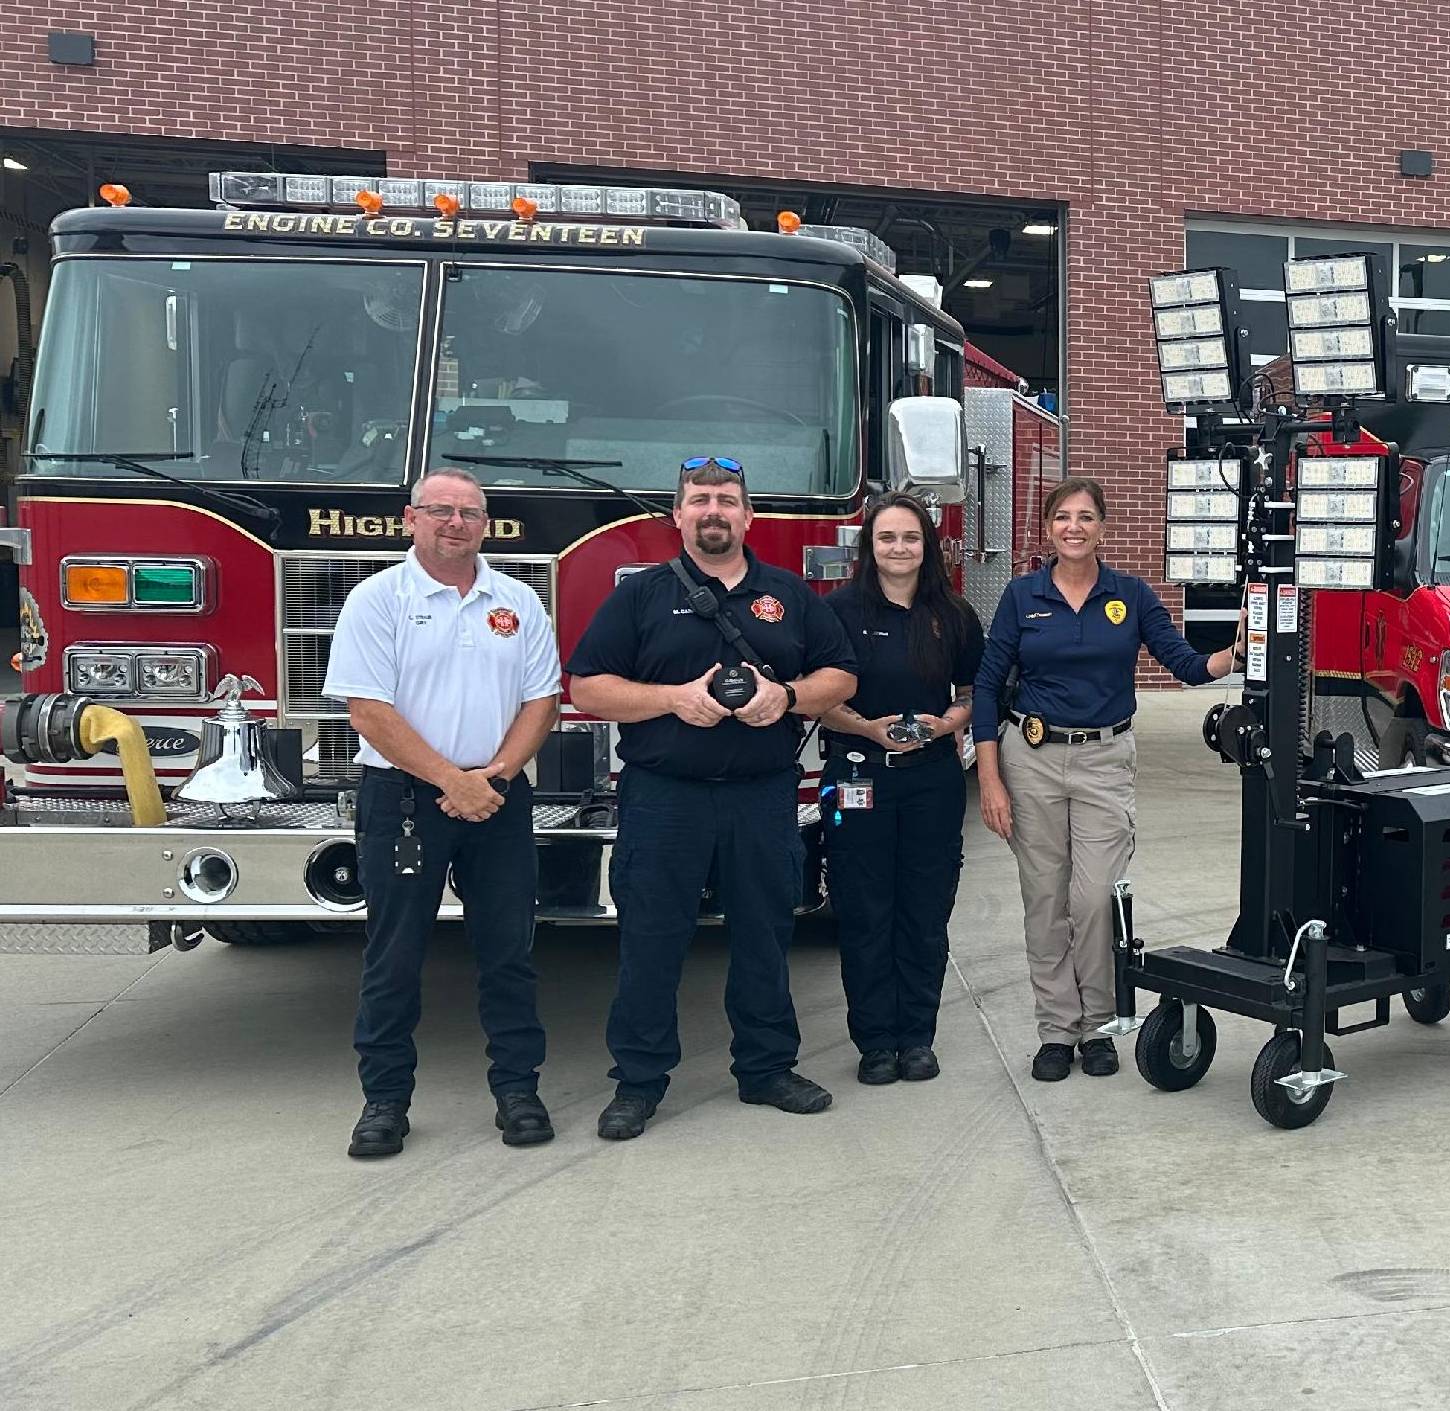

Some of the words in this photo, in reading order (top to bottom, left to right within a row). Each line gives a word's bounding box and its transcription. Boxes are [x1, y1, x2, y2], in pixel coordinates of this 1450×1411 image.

[224, 213, 356, 235] ENGINE
[366, 219, 421, 237] CO.
[433, 220, 645, 245] SEVENTEEN
[308, 508, 523, 538] HIGHD
[146, 737, 185, 750] erce
